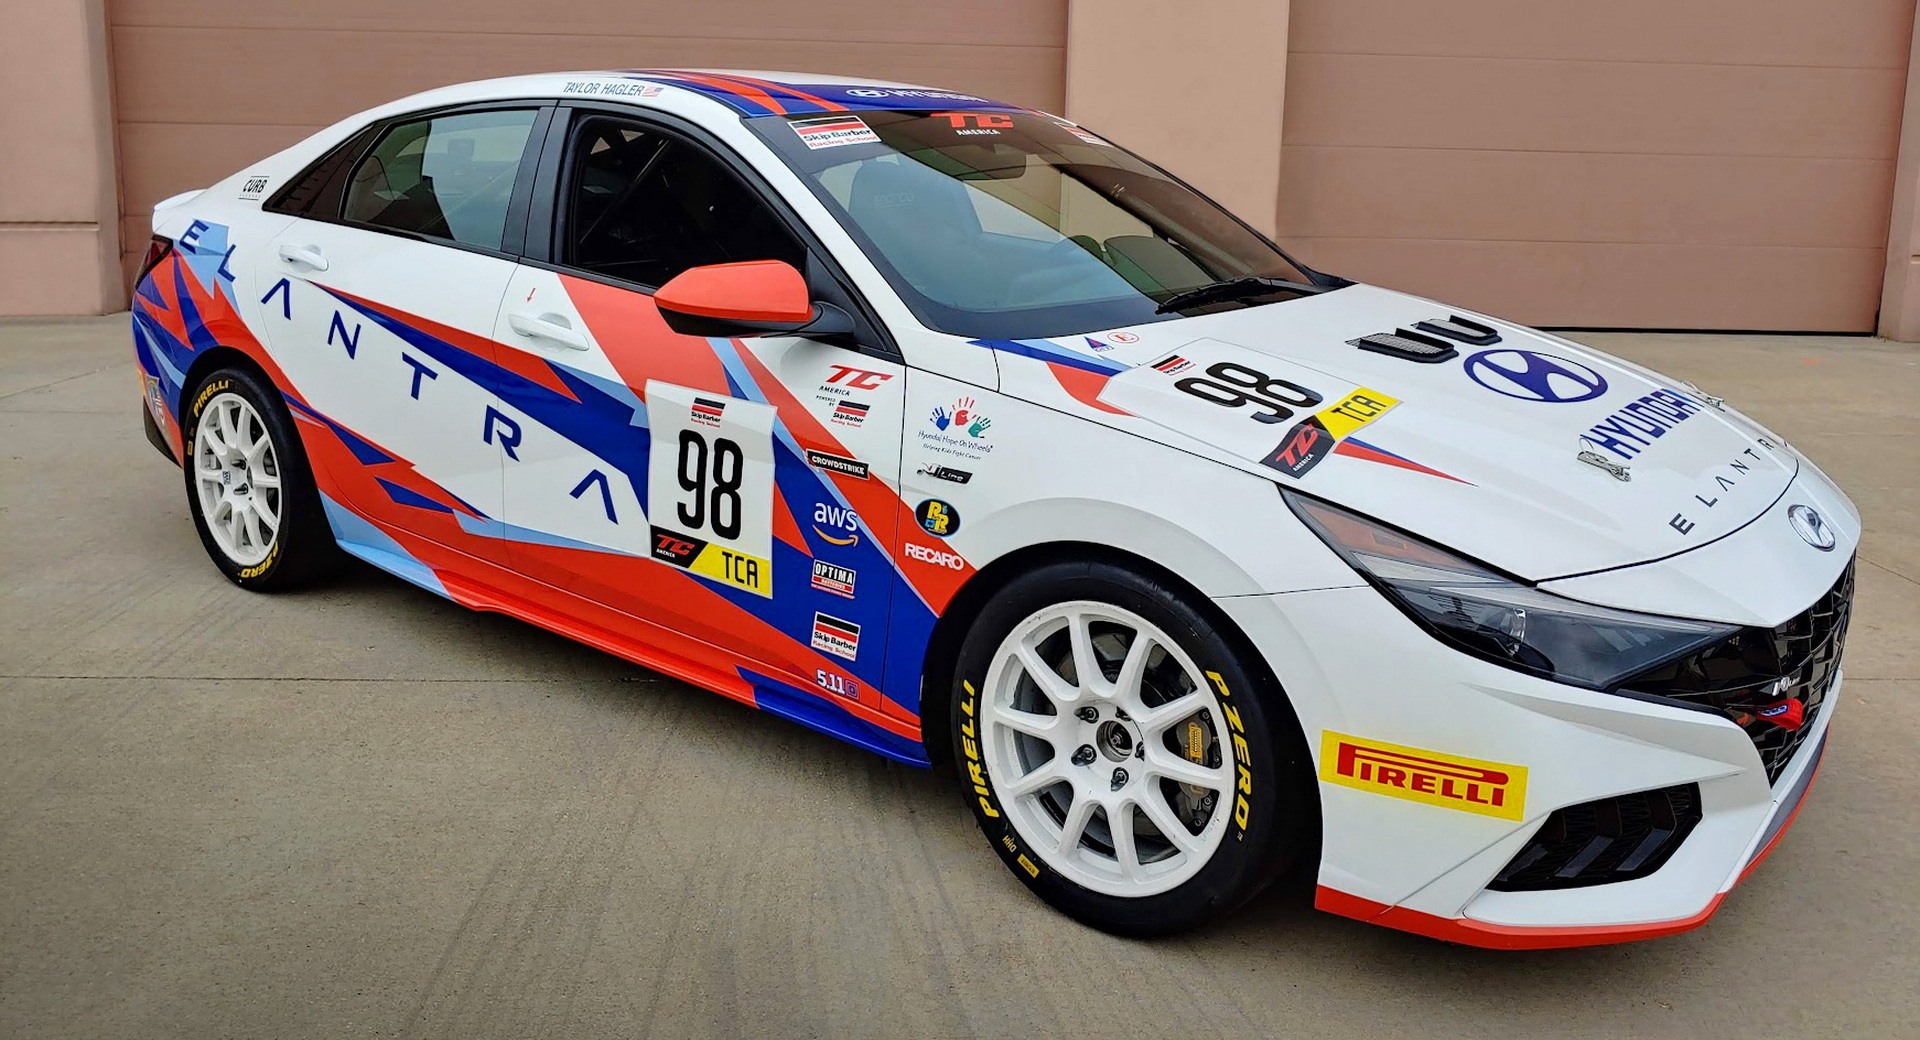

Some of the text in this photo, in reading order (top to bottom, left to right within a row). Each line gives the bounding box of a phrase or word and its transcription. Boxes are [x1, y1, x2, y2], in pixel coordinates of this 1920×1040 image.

[563, 82, 645, 96] TAYLOR HAGLER
[803, 129, 871, 142] Skip Barber
[809, 136, 879, 148] Racing School
[243, 179, 267, 193] CURB
[826, 365, 895, 390] TC
[193, 380, 229, 417] PIRELLI
[819, 385, 850, 396] AMERICA
[1174, 362, 1324, 425] 98
[691, 411, 721, 423] Skip Barber
[833, 412, 864, 423] Skip Barber
[1331, 395, 1387, 423] TCA
[1579, 388, 1706, 460] HYUNDAI
[918, 430, 941, 442] Hyundai
[942, 435, 958, 446] Hope
[968, 441, 991, 453] Wheels
[1275, 423, 1320, 467] TC
[812, 455, 865, 475] CROWDSTRIKE
[1292, 453, 1315, 472] AMERICA
[677, 429, 743, 540] 98
[814, 502, 857, 532] aws
[656, 534, 695, 556] TC
[656, 548, 676, 558] AMERICA
[905, 542, 965, 570] RECARO
[240, 553, 273, 578] ZERO
[722, 551, 758, 588] TCA
[815, 563, 853, 585] OPTIMA
[812, 640, 855, 659] Racing School
[814, 631, 856, 652] Skip Barber
[817, 669, 846, 695] 5.11
[963, 679, 1000, 818] PIRELLI
[1205, 670, 1252, 833] P ZERO
[1337, 742, 1509, 806] PIRELLI
